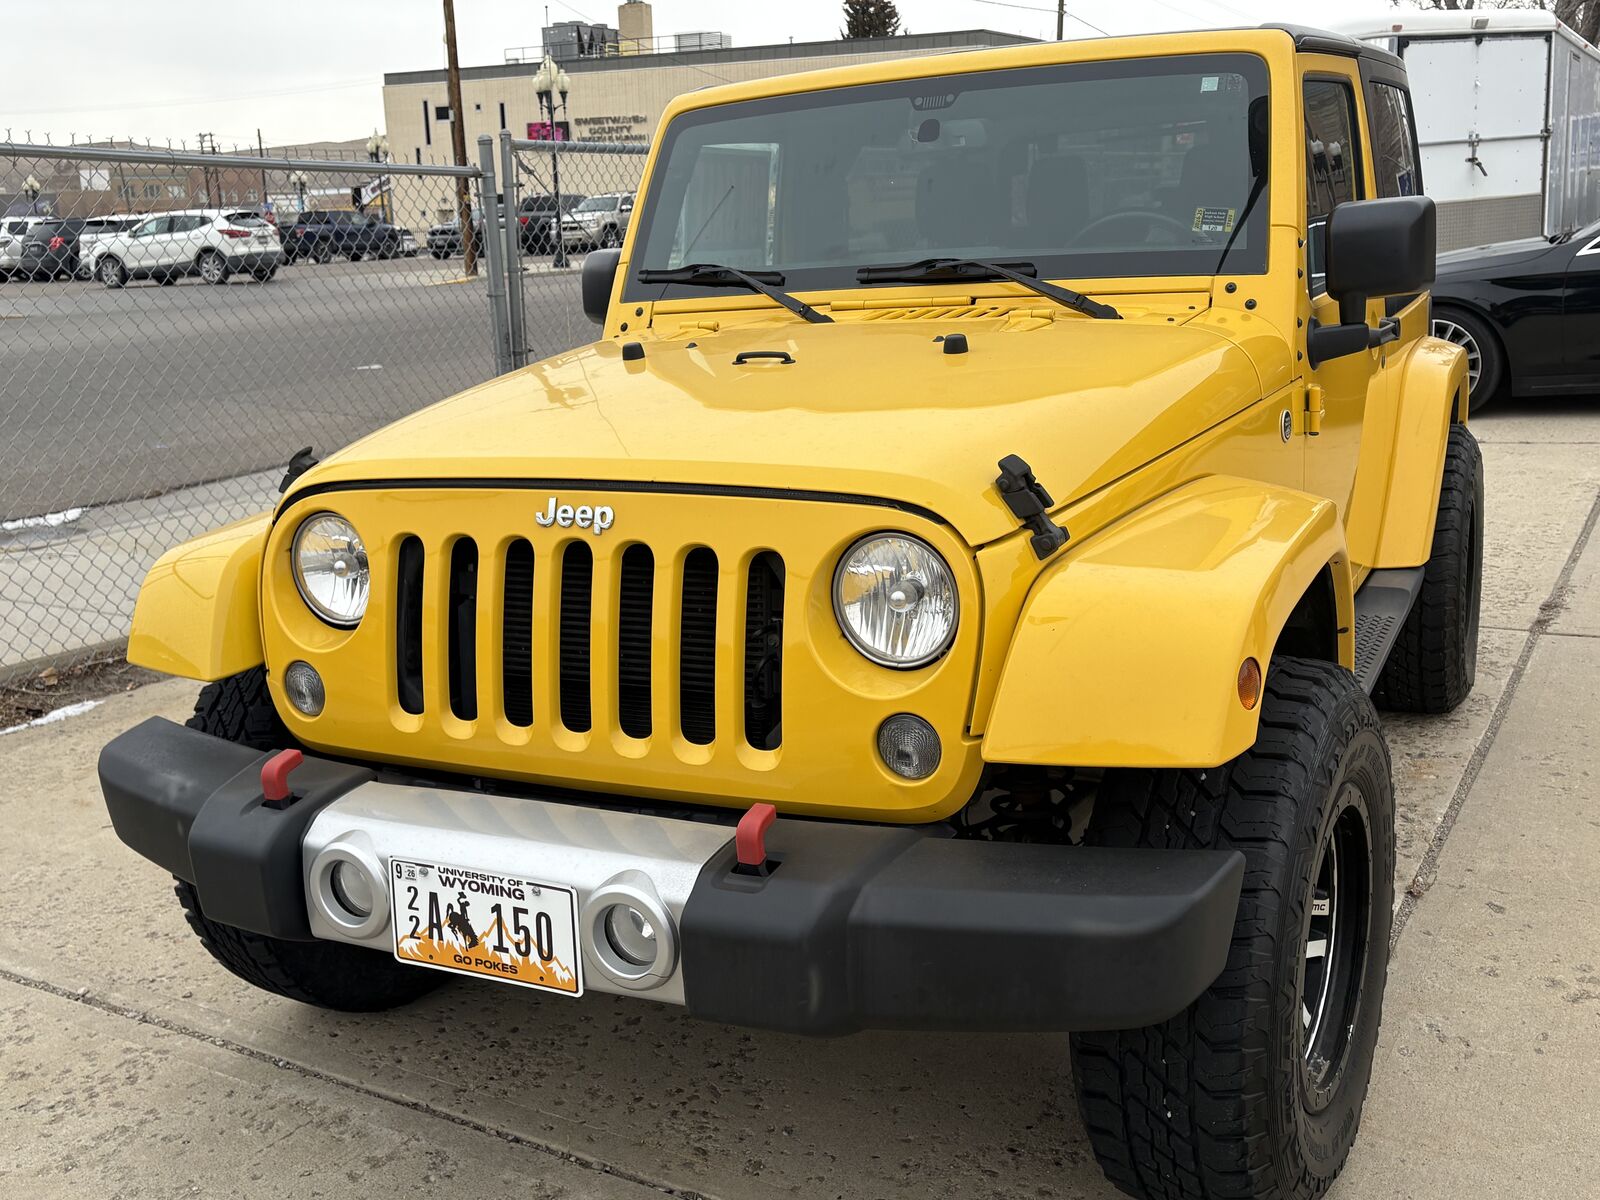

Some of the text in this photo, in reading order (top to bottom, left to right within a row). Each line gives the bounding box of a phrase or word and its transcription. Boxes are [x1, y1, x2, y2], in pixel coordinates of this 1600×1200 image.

[574, 115, 648, 126] SWEETWATER
[589, 125, 633, 135] COUNTY
[535, 496, 615, 536] Jeep
[395, 863, 403, 880] 9
[407, 868, 416, 878] 26
[437, 866, 524, 888] UNIVERSITY OF
[438, 874, 526, 901] WYOMING
[428, 891, 554, 962] A 150
[453, 954, 519, 975] GO POKES
